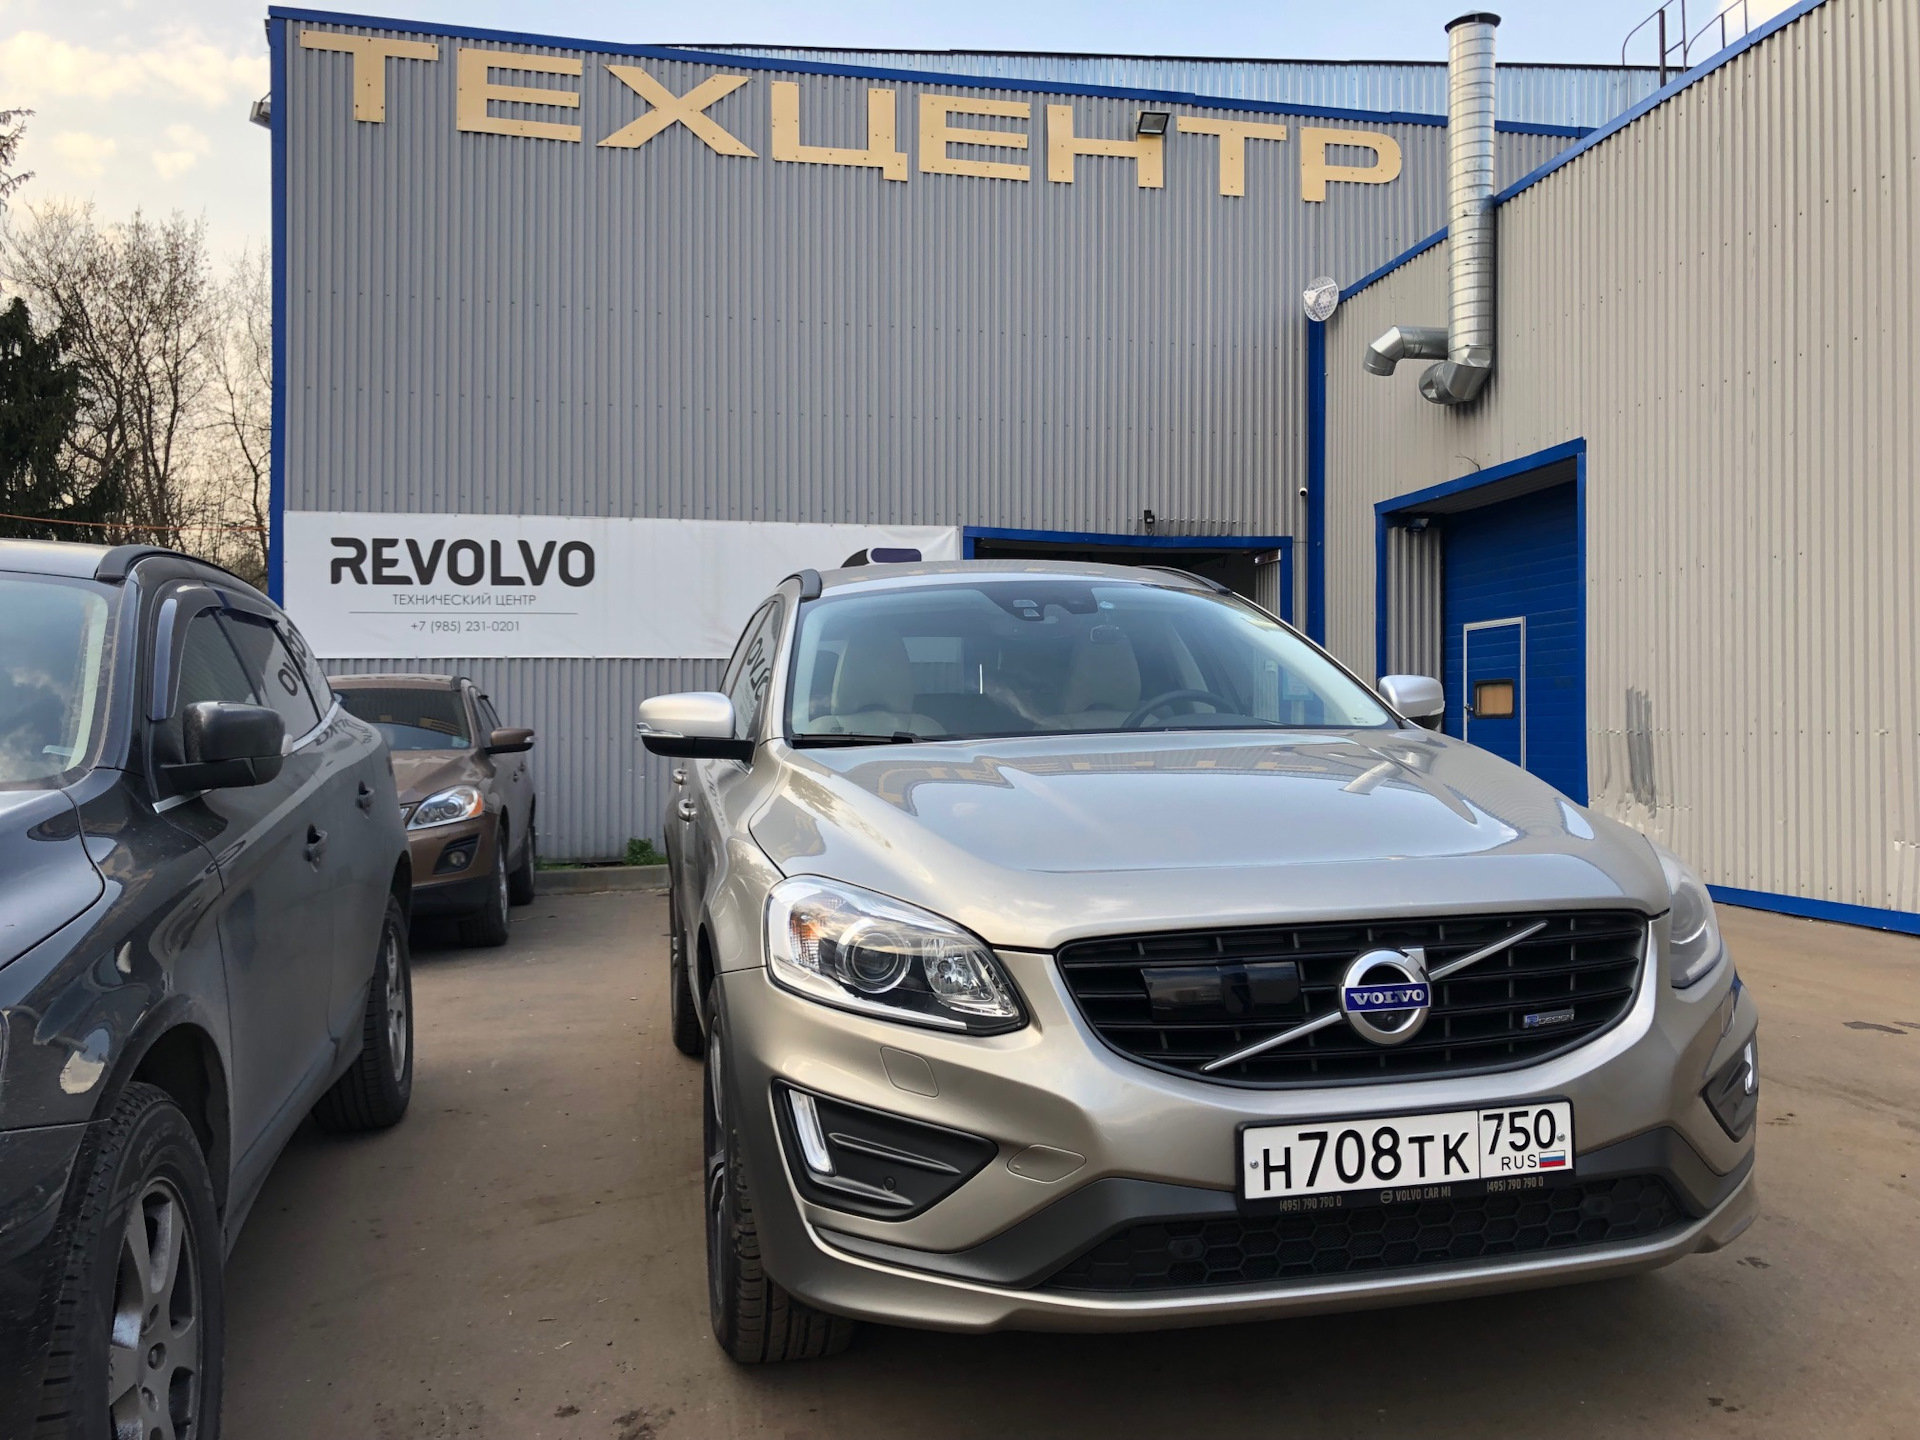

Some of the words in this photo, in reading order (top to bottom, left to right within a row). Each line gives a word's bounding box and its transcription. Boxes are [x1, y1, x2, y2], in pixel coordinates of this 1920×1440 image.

[299, 29, 1402, 202] ТЕХЦЕНТР
[330, 537, 595, 587] REVOLVO
[392, 592, 491, 606] ТЕХНИЧЕСКИЙ
[495, 594, 537, 607] ЦЕНТР
[410, 621, 426, 632] +7
[430, 620, 461, 633] (985)
[465, 620, 520, 632] 231-0201
[1350, 988, 1425, 1006] VOLVO
[1482, 1108, 1557, 1156] 750
[1501, 1154, 1538, 1172] RUS
[1486, 1180, 1506, 1193] (495)
[1508, 1179, 1522, 1190] 790
[1523, 1177, 1537, 1189] 790
[1395, 1188, 1422, 1202] VOLVO
[1423, 1187, 1439, 1199] CAR
[1279, 1198, 1300, 1212] (495)
[1303, 1197, 1318, 1210] 790
[1320, 1195, 1335, 1208] 790
